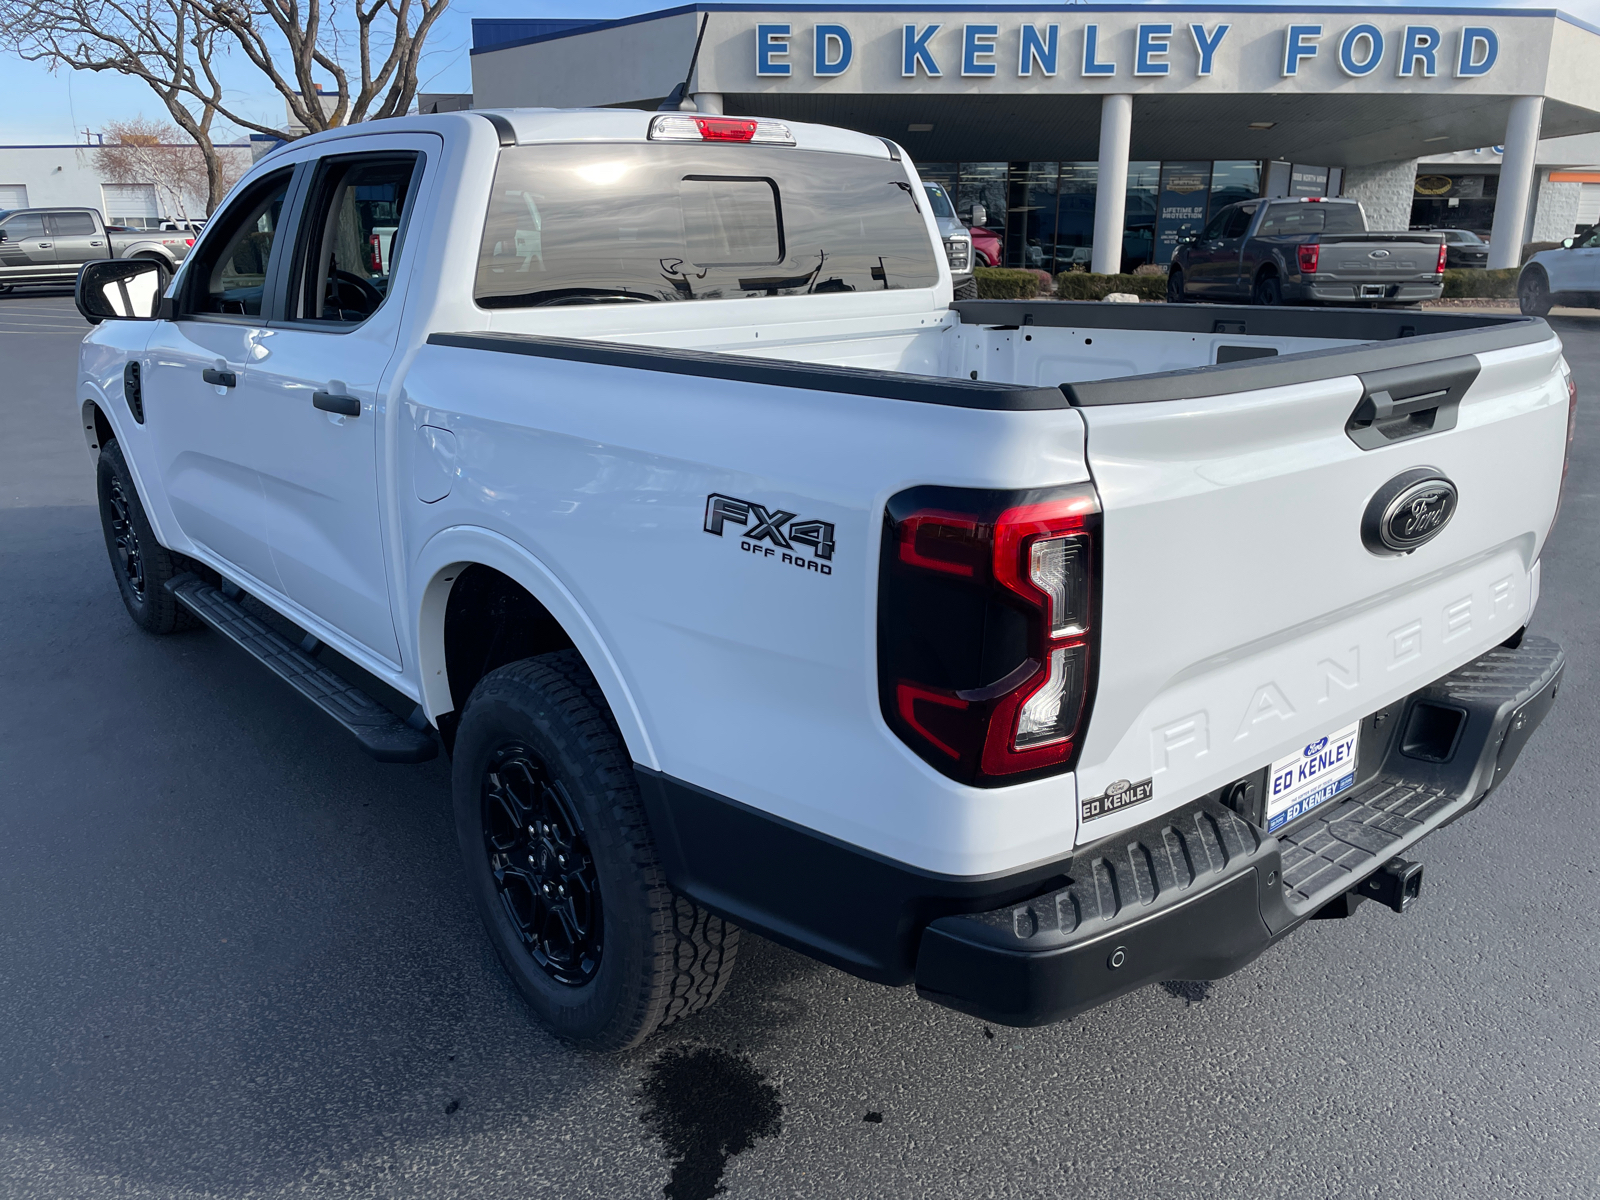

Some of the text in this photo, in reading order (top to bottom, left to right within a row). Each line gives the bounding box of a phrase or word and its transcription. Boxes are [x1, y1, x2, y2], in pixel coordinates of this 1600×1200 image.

[755, 22, 1500, 78] ED KENLEY FORD
[1338, 260, 1417, 270] F-150
[703, 492, 836, 561] FX4
[1405, 494, 1446, 536] Ford
[741, 541, 832, 576] OFF ROAD
[1151, 573, 1515, 775] RANGER
[1273, 738, 1354, 796] ED KENLEY
[1307, 739, 1325, 756] Ford
[1082, 782, 1152, 818] ED KENLEY
[1286, 804, 1300, 821] ED
[1302, 781, 1338, 812] KENLEY
